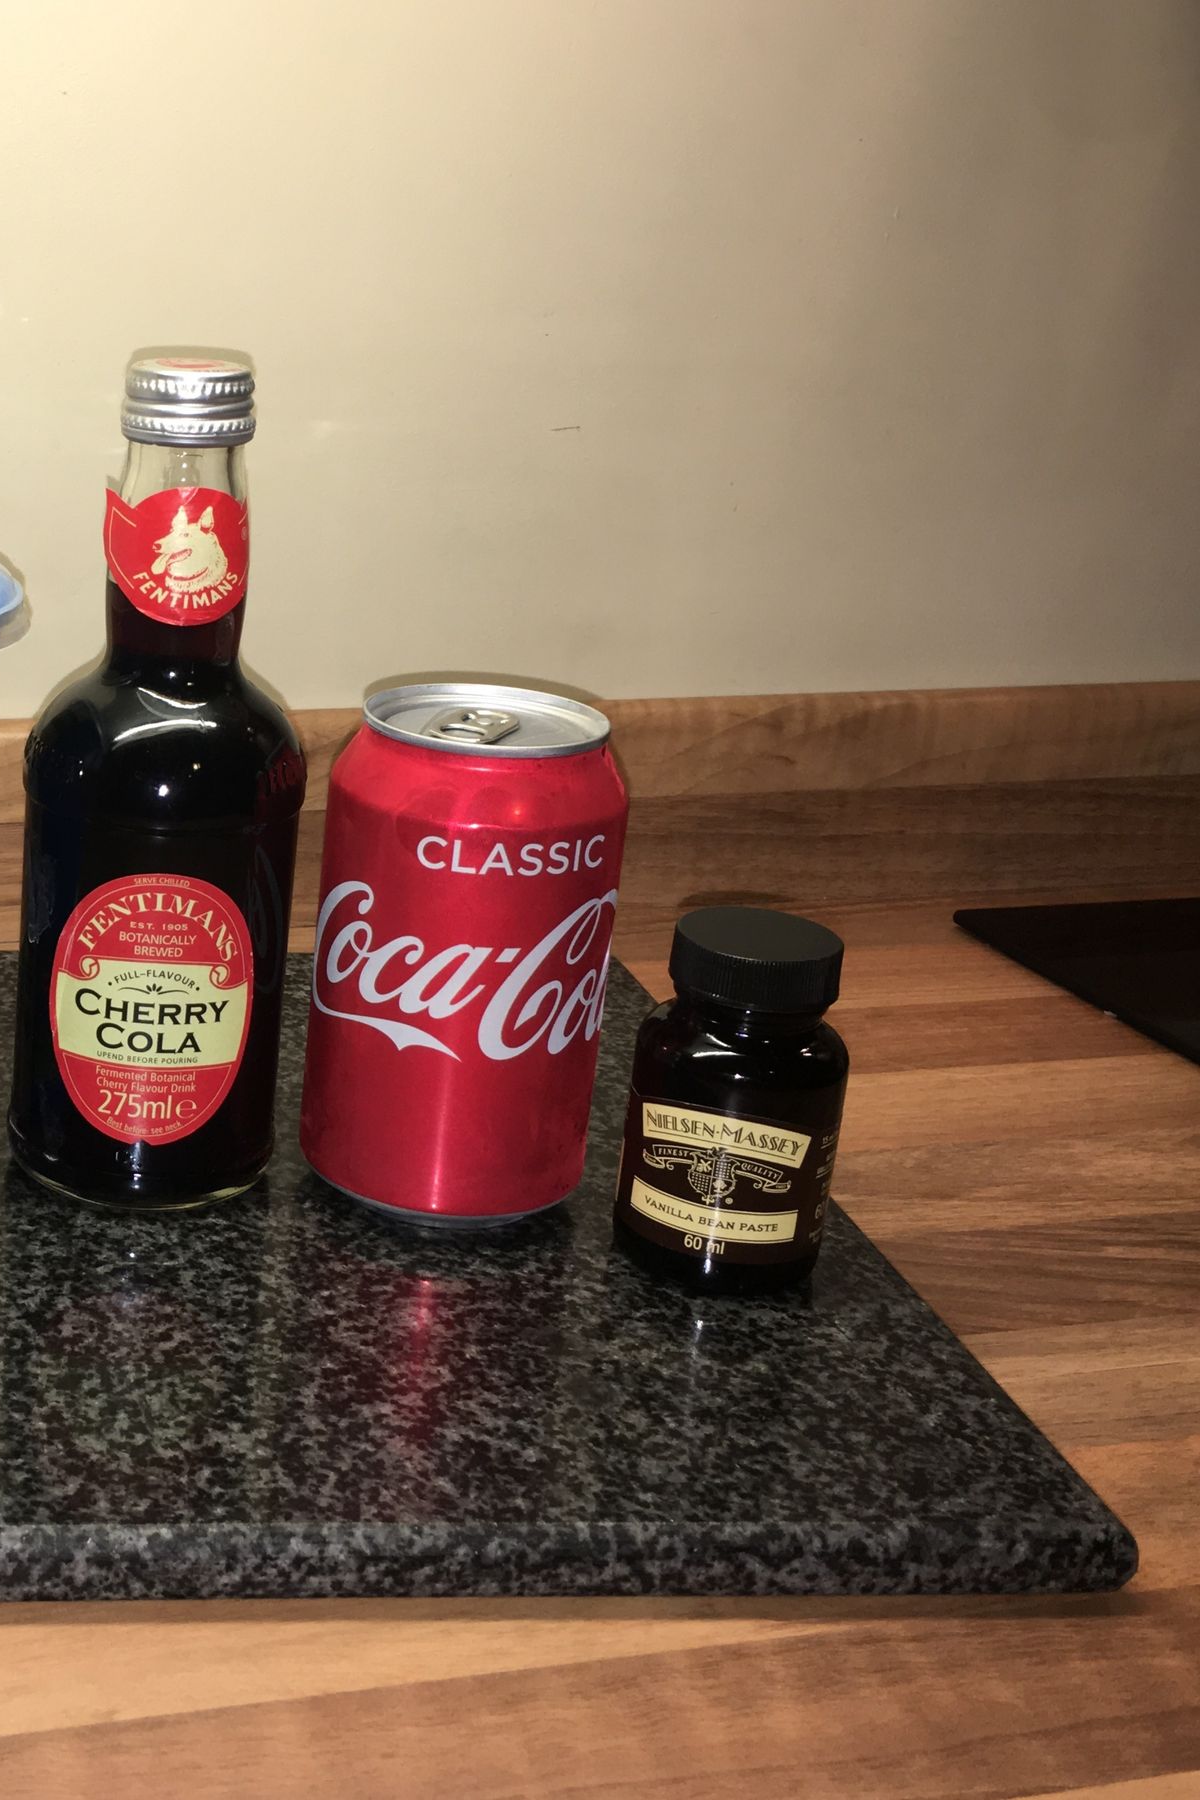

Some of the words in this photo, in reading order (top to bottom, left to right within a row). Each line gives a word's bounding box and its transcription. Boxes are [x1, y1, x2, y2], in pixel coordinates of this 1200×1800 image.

[132, 570, 240, 610] FENTIMANS
[416, 834, 606, 876] CLASSIC
[134, 877, 157, 886] SERVE
[158, 877, 190, 888] CHILLED
[77, 892, 238, 962] FENTIMANS
[129, 921, 155, 930] EST.
[162, 923, 189, 931] 1905
[119, 931, 197, 945] BOTANICALLY
[134, 945, 184, 957] BREWED
[114, 969, 195, 989] FULL-FLAVOUR
[74, 988, 230, 1026] CHERRY
[96, 1022, 202, 1055] COLA
[97, 1050, 124, 1060] UPEND
[126, 1056, 157, 1064] BEFORE
[161, 1056, 198, 1064] POURING
[96, 1065, 147, 1080] Fermented
[150, 1071, 196, 1081] Botanical
[96, 1076, 128, 1091] Cherry
[131, 1081, 168, 1093] Flavour
[171, 1083, 196, 1093] Drink
[97, 1089, 172, 1119] 275ml
[106, 1116, 123, 1129] Best
[151, 1127, 164, 1135] see
[165, 1120, 181, 1132] neck
[658, 1148, 689, 1157] FINEST
[741, 1163, 779, 1179] QUALITY
[644, 1195, 694, 1223] VANILLA
[698, 1216, 735, 1231] BEAN
[740, 1223, 779, 1233] PASTE
[684, 1234, 702, 1250] 60
[706, 1239, 725, 1255] ml
